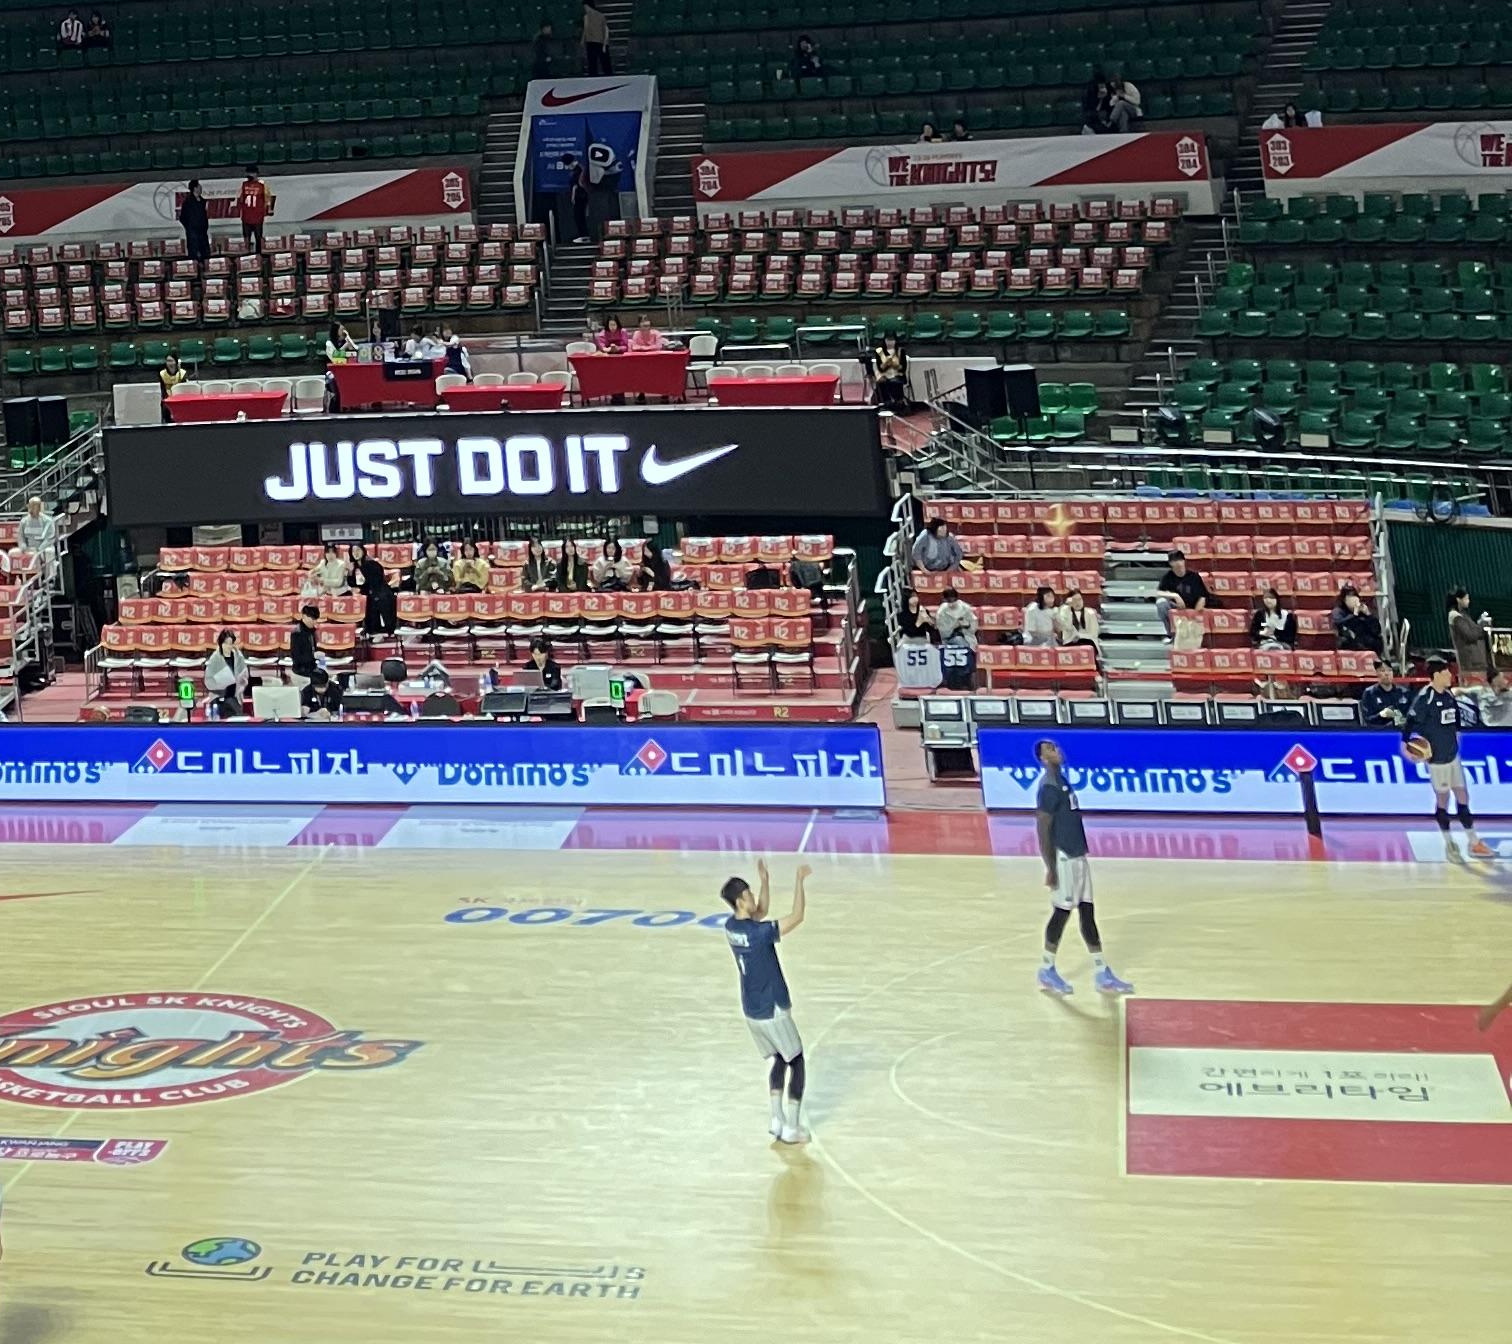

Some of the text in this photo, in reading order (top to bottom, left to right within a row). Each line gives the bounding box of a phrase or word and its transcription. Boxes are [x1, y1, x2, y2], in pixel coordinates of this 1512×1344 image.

[888, 156, 911, 173] WE
[909, 160, 999, 186] KNIGHTS!
[264, 434, 630, 501] JUST DO IT
[907, 649, 928, 666] 55
[943, 649, 968, 667] 55
[33, 995, 309, 1030] SEOUL SK KNIGHTS
[159, 1077, 251, 1102] CLUB
[1199, 1081, 1430, 1102] 에브리타임
[302, 1252, 389, 1267] PLAY
[395, 1255, 461, 1273] FOR
[290, 1269, 641, 1300] CHANGE FOR EARTH
